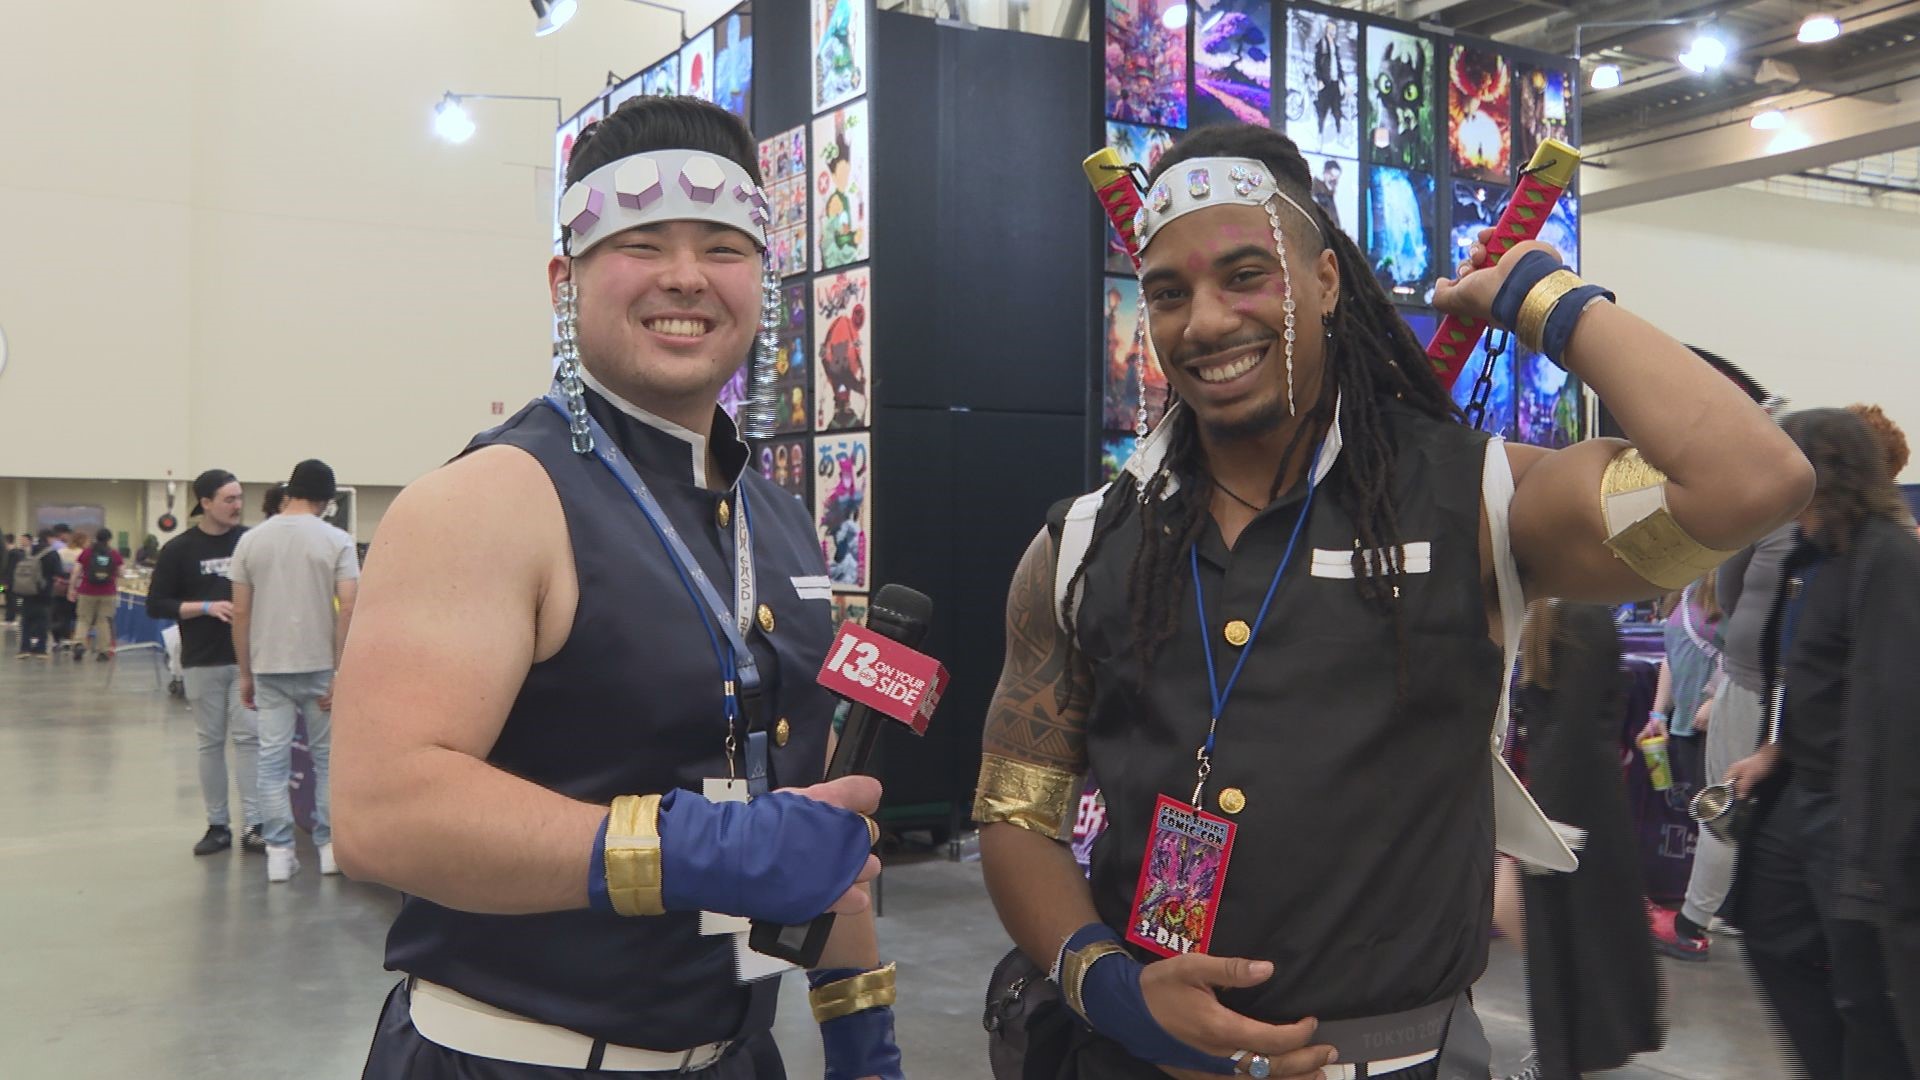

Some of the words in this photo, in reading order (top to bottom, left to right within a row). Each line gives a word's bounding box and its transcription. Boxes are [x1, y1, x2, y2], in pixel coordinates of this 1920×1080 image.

[827, 633, 880, 682] 13
[875, 661, 895, 676] ON
[894, 669, 926, 691] YOUR
[875, 676, 921, 706] SIDE
[1140, 920, 1193, 953] 3-DAY
[1362, 1026, 1416, 1049] TOKYO
